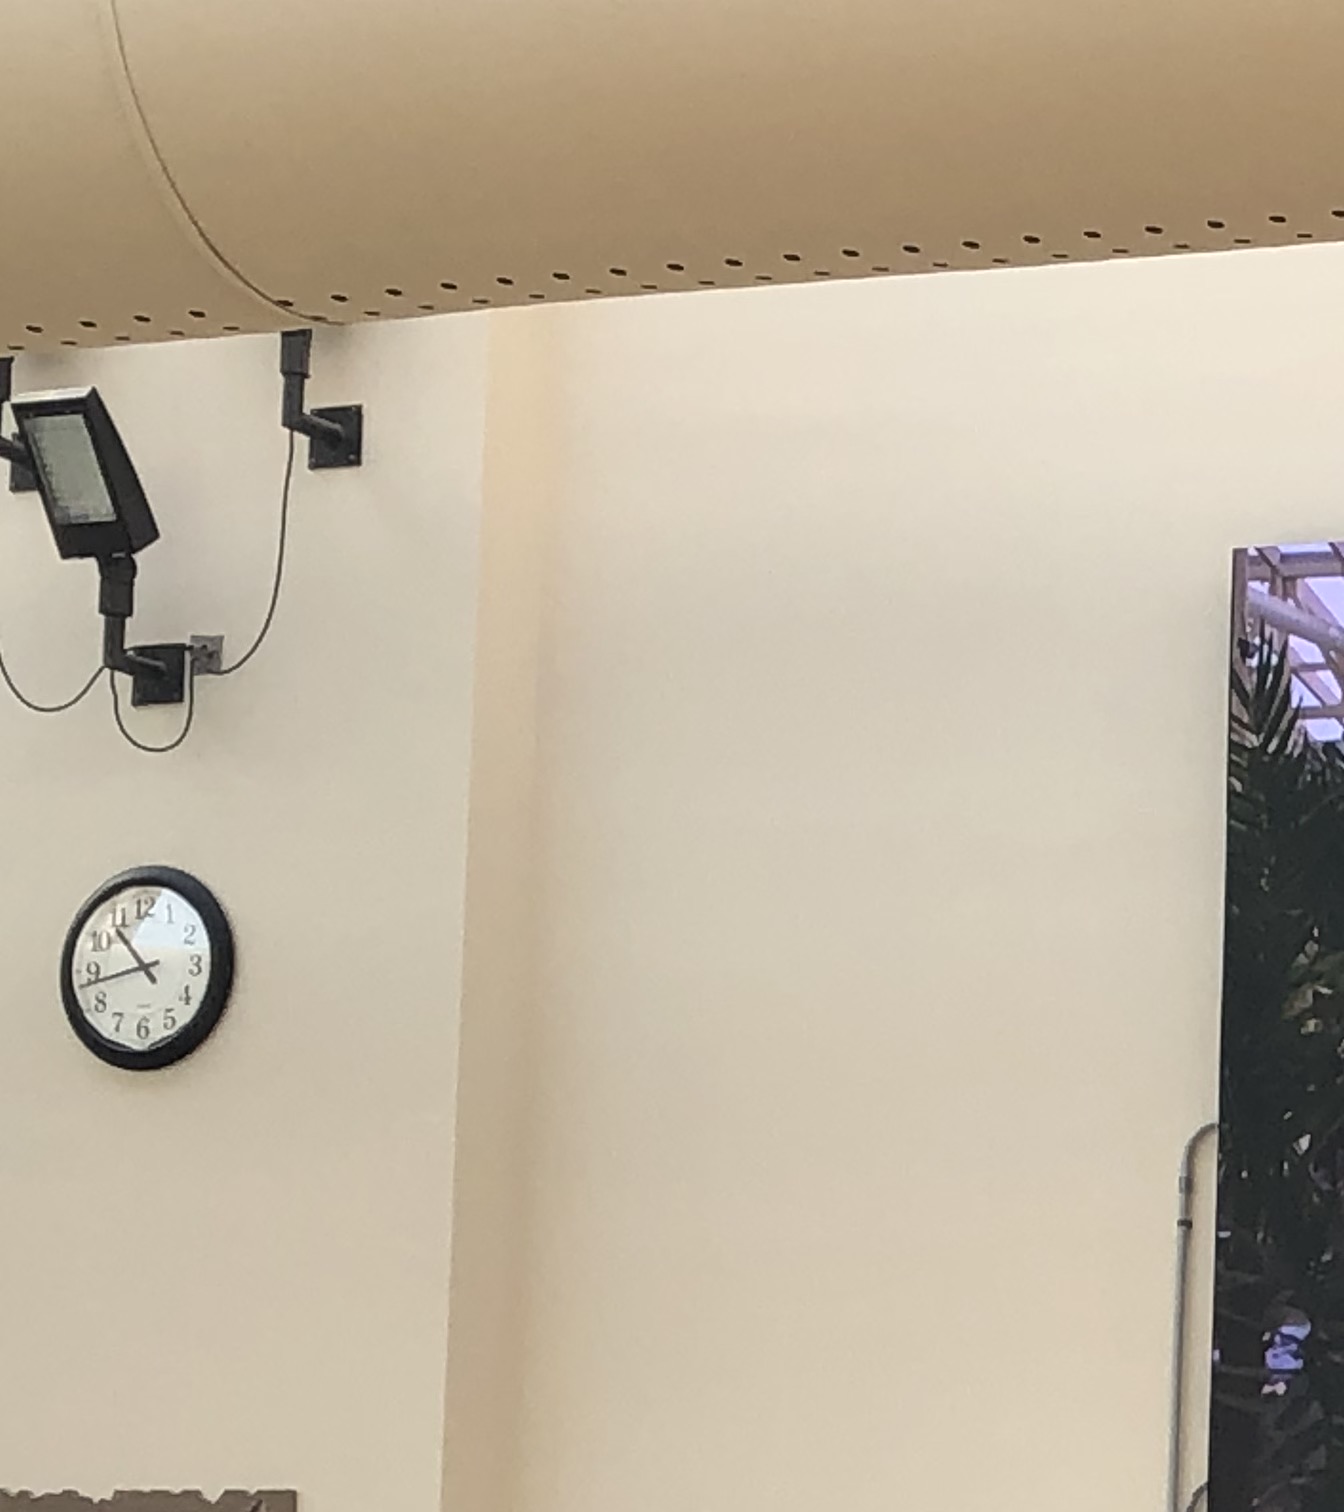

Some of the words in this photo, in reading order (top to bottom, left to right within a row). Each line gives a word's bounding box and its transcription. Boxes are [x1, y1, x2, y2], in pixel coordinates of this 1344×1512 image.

[110, 907, 128, 928] 11
[134, 896, 156, 919] 12
[166, 904, 174, 924] 1
[91, 930, 111, 952] 10
[183, 925, 196, 945] 2
[86, 962, 101, 983] 9
[189, 955, 202, 976] 3
[94, 992, 107, 1014] 8
[179, 985, 192, 1005] 4
[111, 1012, 124, 1032] 7
[136, 1017, 150, 1040] 6
[163, 1008, 176, 1030] 5
